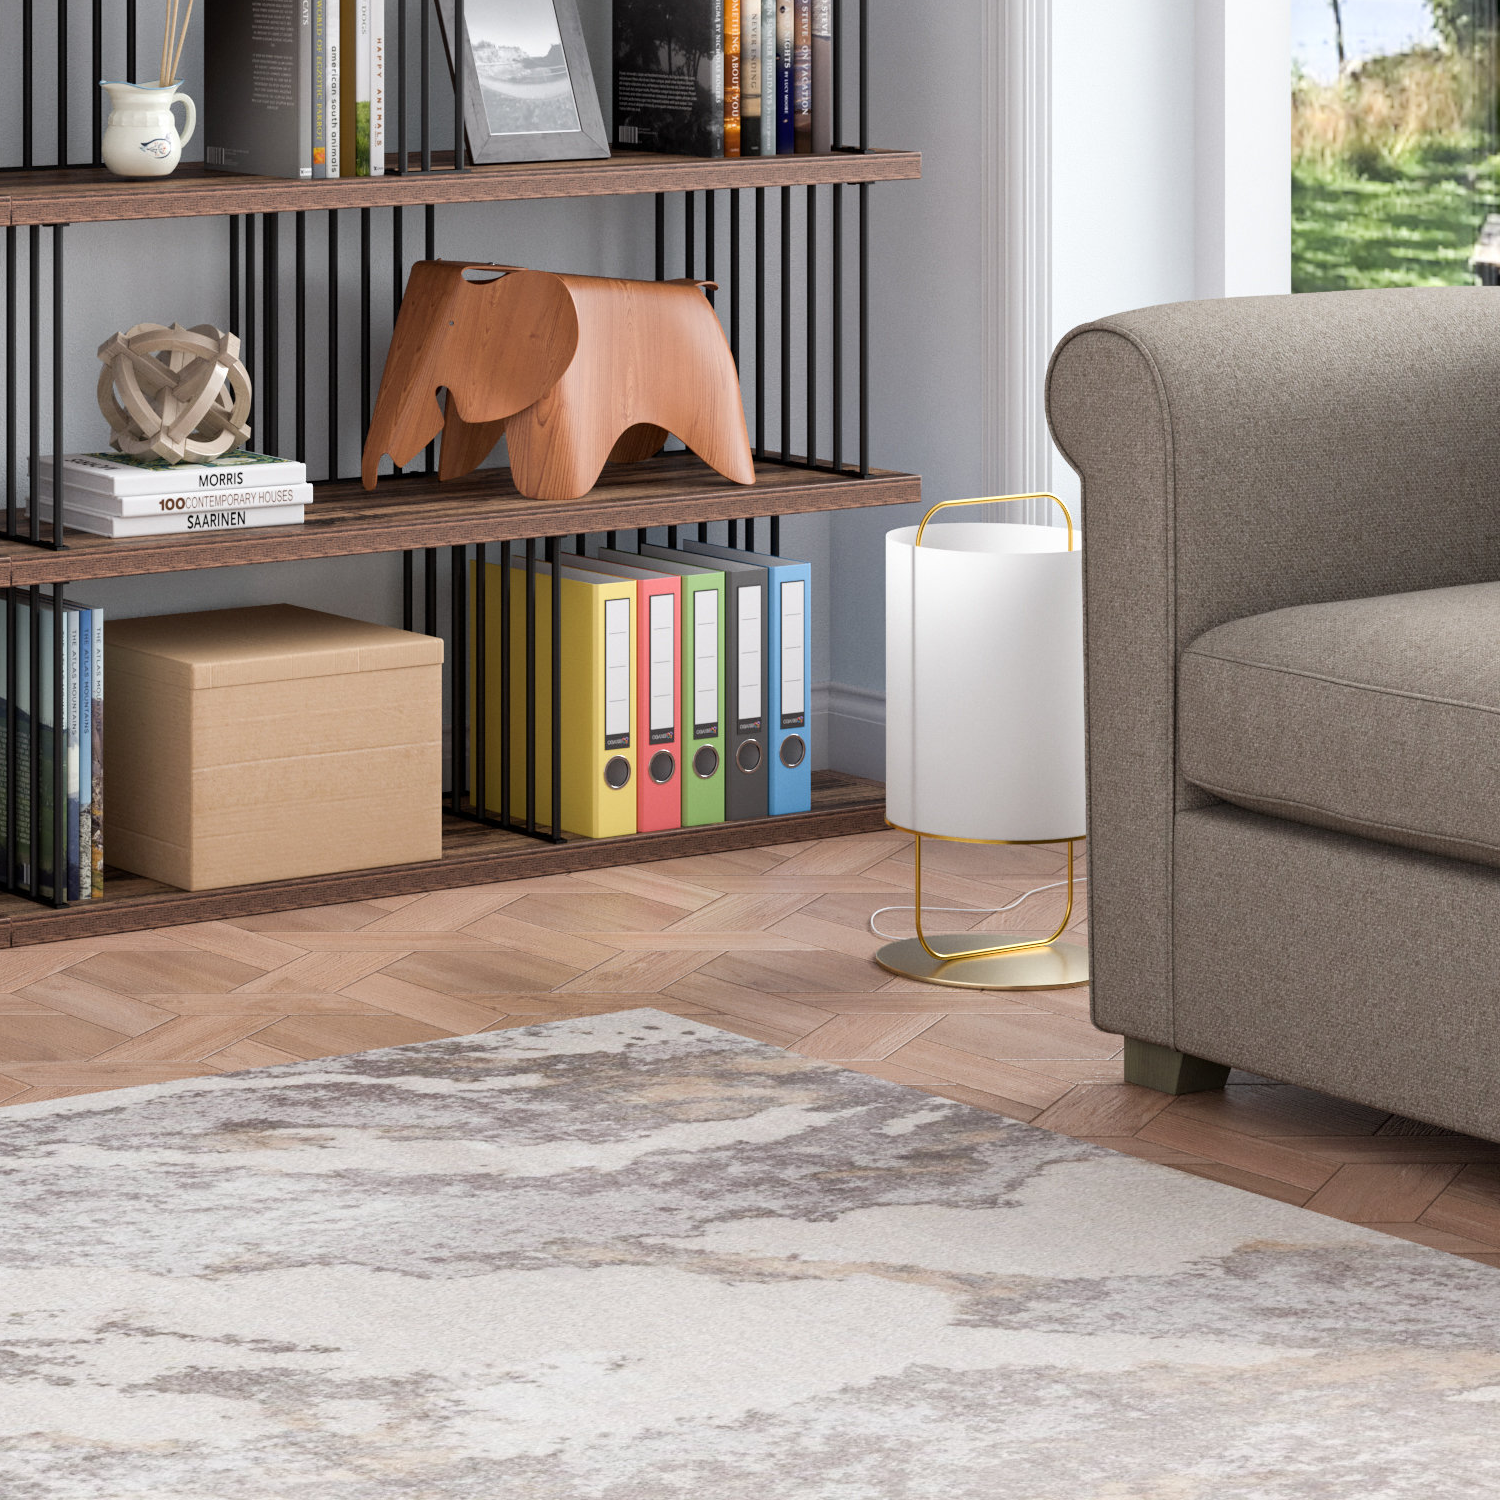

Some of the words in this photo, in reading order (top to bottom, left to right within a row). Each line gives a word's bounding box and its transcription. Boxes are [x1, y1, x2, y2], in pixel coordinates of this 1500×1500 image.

[198, 472, 243, 487] MORRIS
[258, 489, 293, 503] HOUSES
[187, 511, 246, 529] SAARINEN
